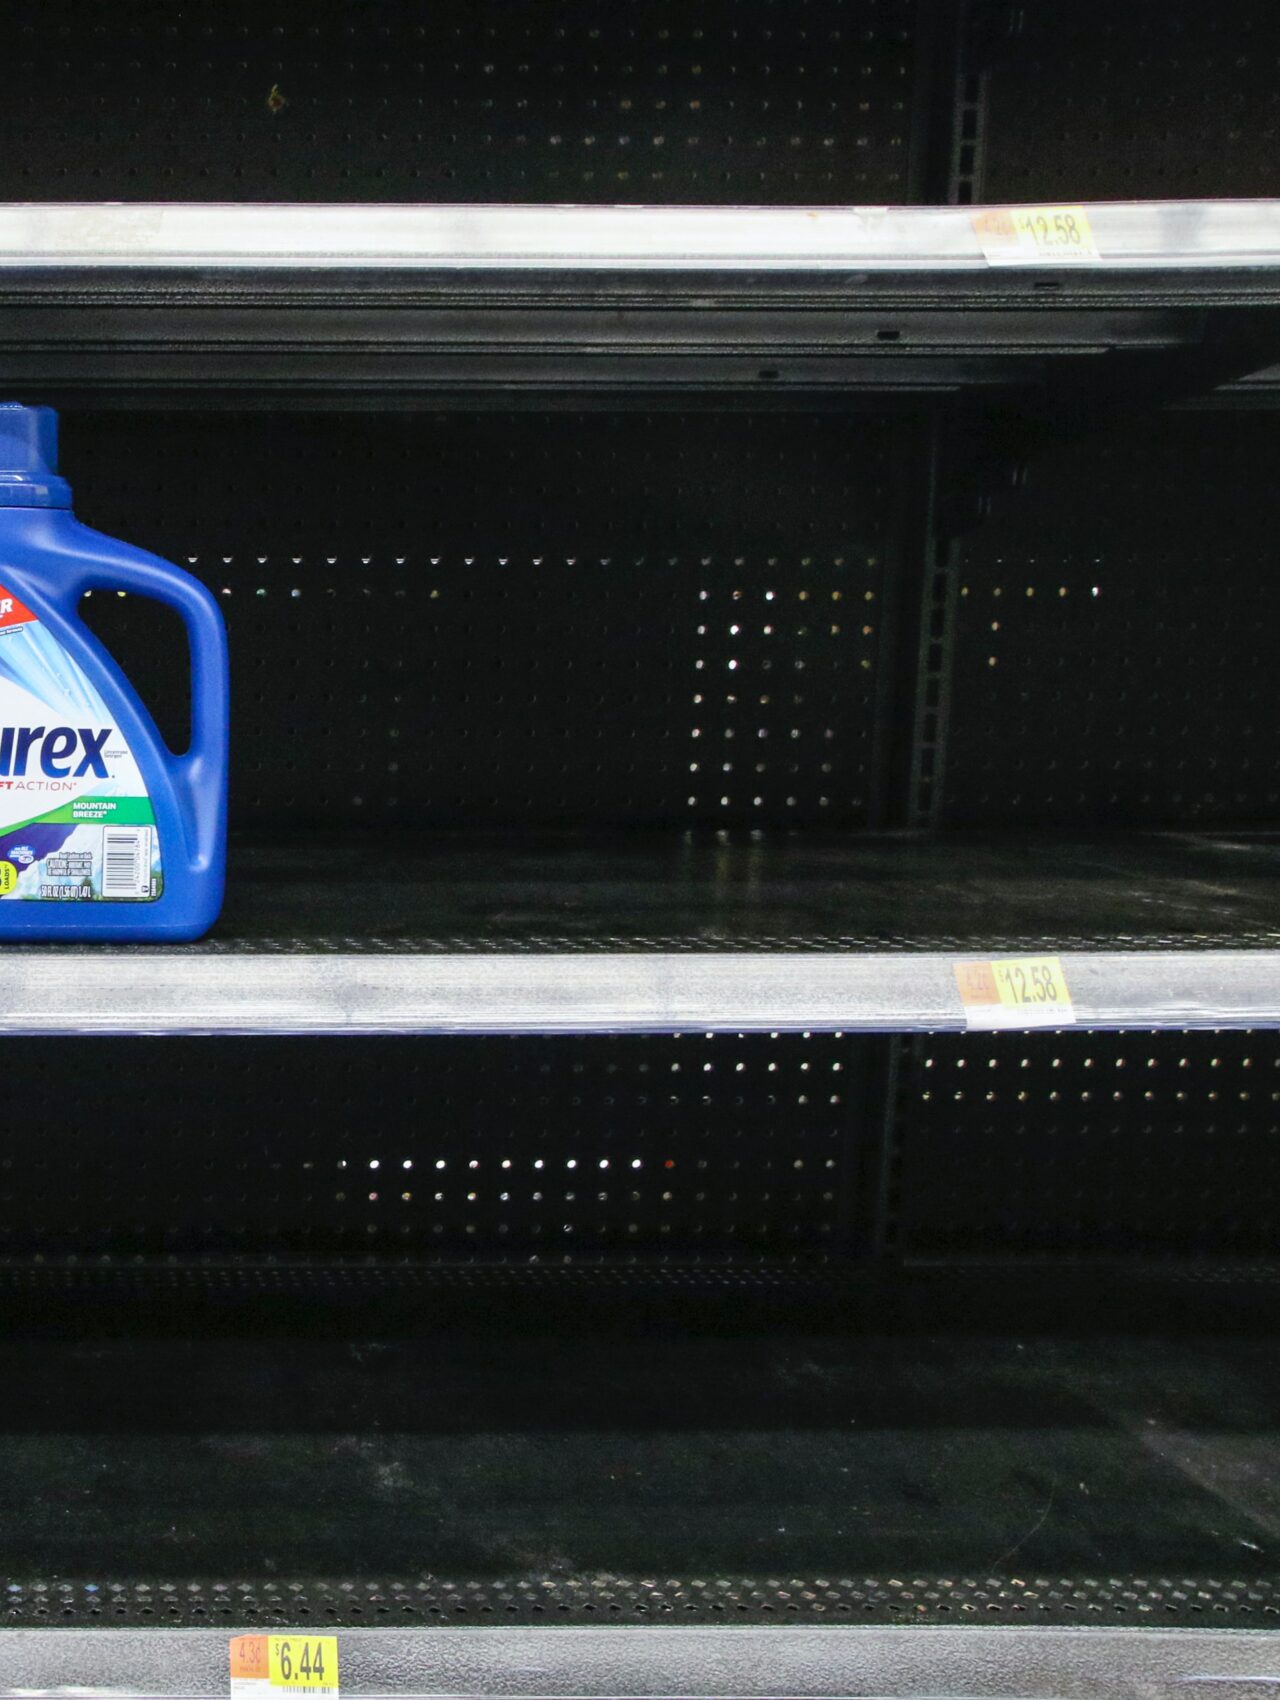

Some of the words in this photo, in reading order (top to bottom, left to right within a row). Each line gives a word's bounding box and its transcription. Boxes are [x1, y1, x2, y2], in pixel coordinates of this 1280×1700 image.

[72, 802, 117, 810] MOUNTAIN
[999, 965, 1058, 1004] $12.58
[275, 1641, 325, 1682] $6.44
